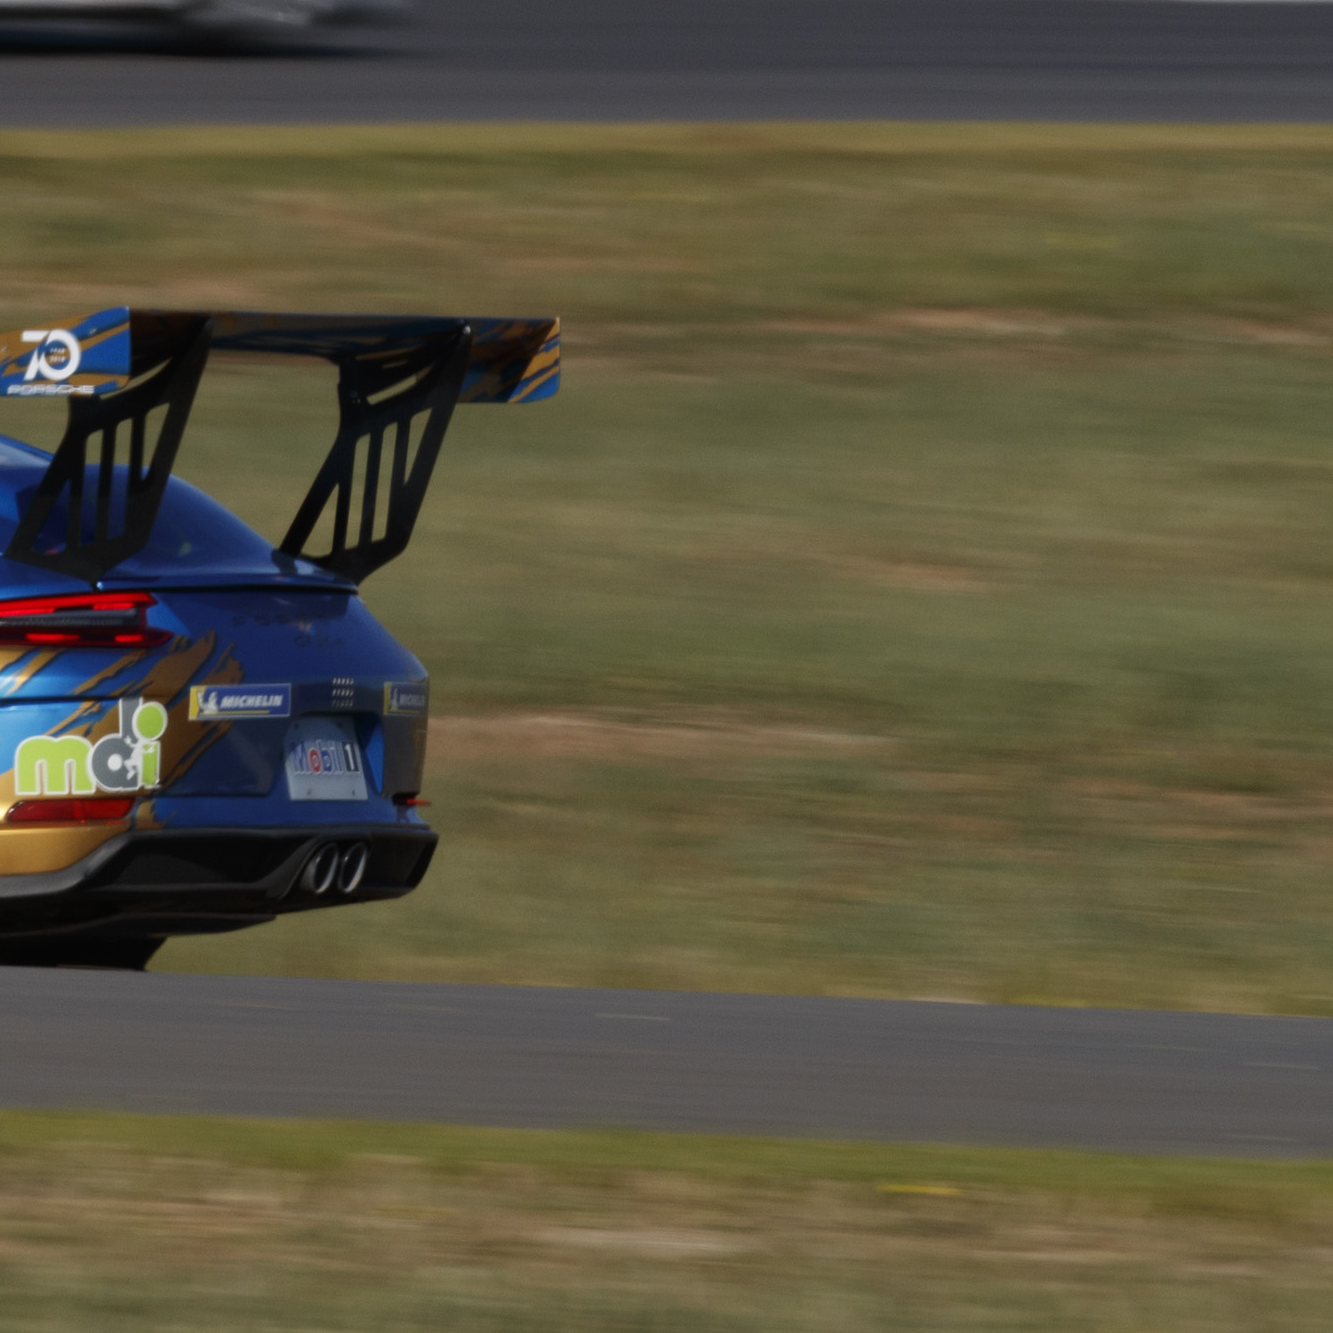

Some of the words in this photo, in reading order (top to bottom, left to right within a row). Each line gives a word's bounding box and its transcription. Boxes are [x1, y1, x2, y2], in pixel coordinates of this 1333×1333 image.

[21, 329, 81, 381] 70
[7, 384, 94, 395] PORSCHE
[220, 694, 284, 709] MICHELIN
[291, 739, 344, 774] Mobil
[344, 742, 359, 772] 1
